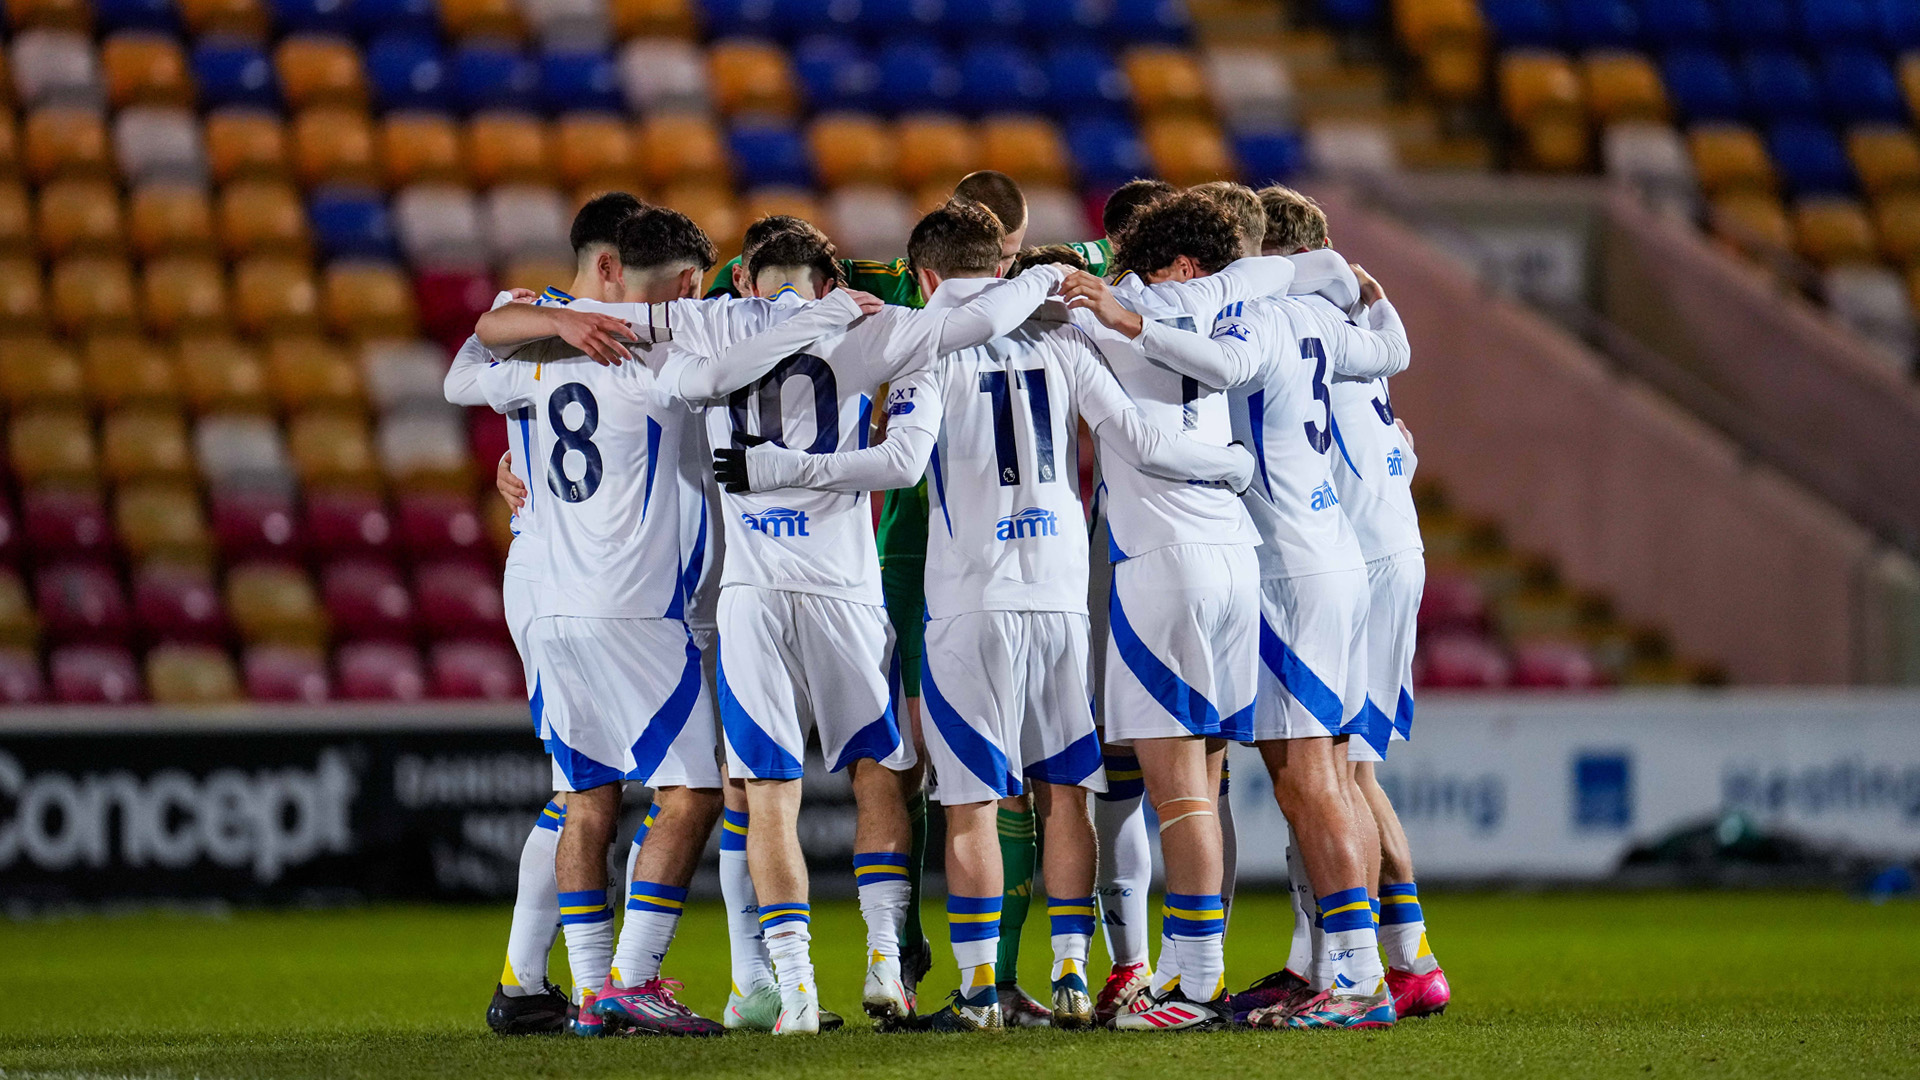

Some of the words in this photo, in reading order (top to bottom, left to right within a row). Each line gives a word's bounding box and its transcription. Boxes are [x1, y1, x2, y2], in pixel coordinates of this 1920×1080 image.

[548, 382, 603, 503] 8
[978, 368, 1056, 487] 11
[1298, 337, 1332, 455] 3
[741, 510, 809, 537] amt
[996, 514, 1058, 541] amt
